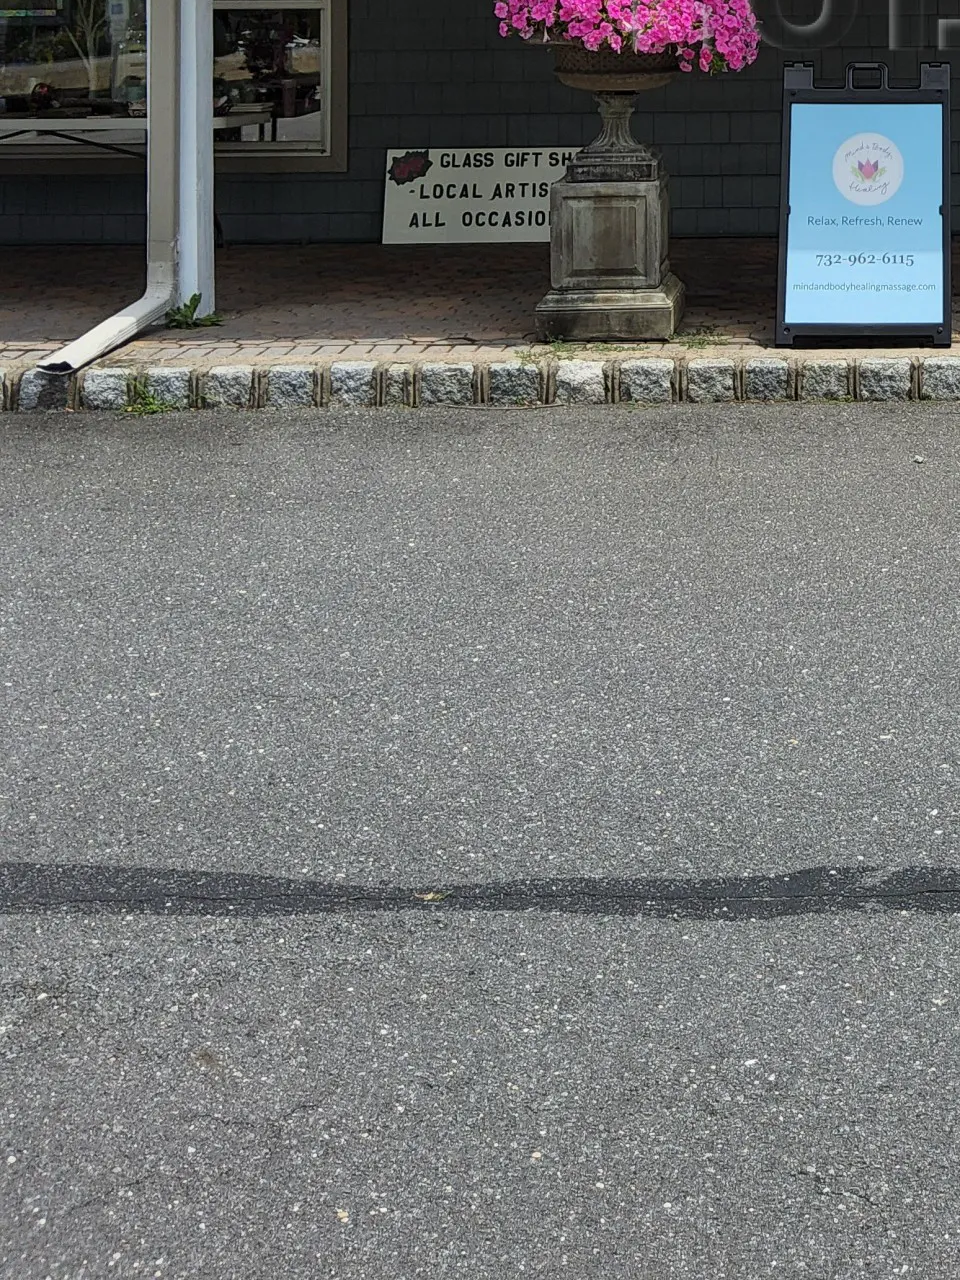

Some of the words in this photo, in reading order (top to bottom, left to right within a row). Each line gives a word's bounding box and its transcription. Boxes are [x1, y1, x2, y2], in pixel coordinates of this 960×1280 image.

[440, 152, 494, 168] GLASS
[504, 152, 543, 167] GIFT
[548, 151, 572, 167] SH
[489, 182, 549, 200] ARTIS
[409, 212, 446, 228] ALL
[462, 210, 551, 227] OCCASIO
[807, 215, 839, 226] Relax,
[841, 215, 885, 227] Refresh,
[887, 216, 923, 226] Renew
[815, 252, 914, 266] 732-962-6115
[792, 281, 936, 292] mindandbodyhealingmassage.com
